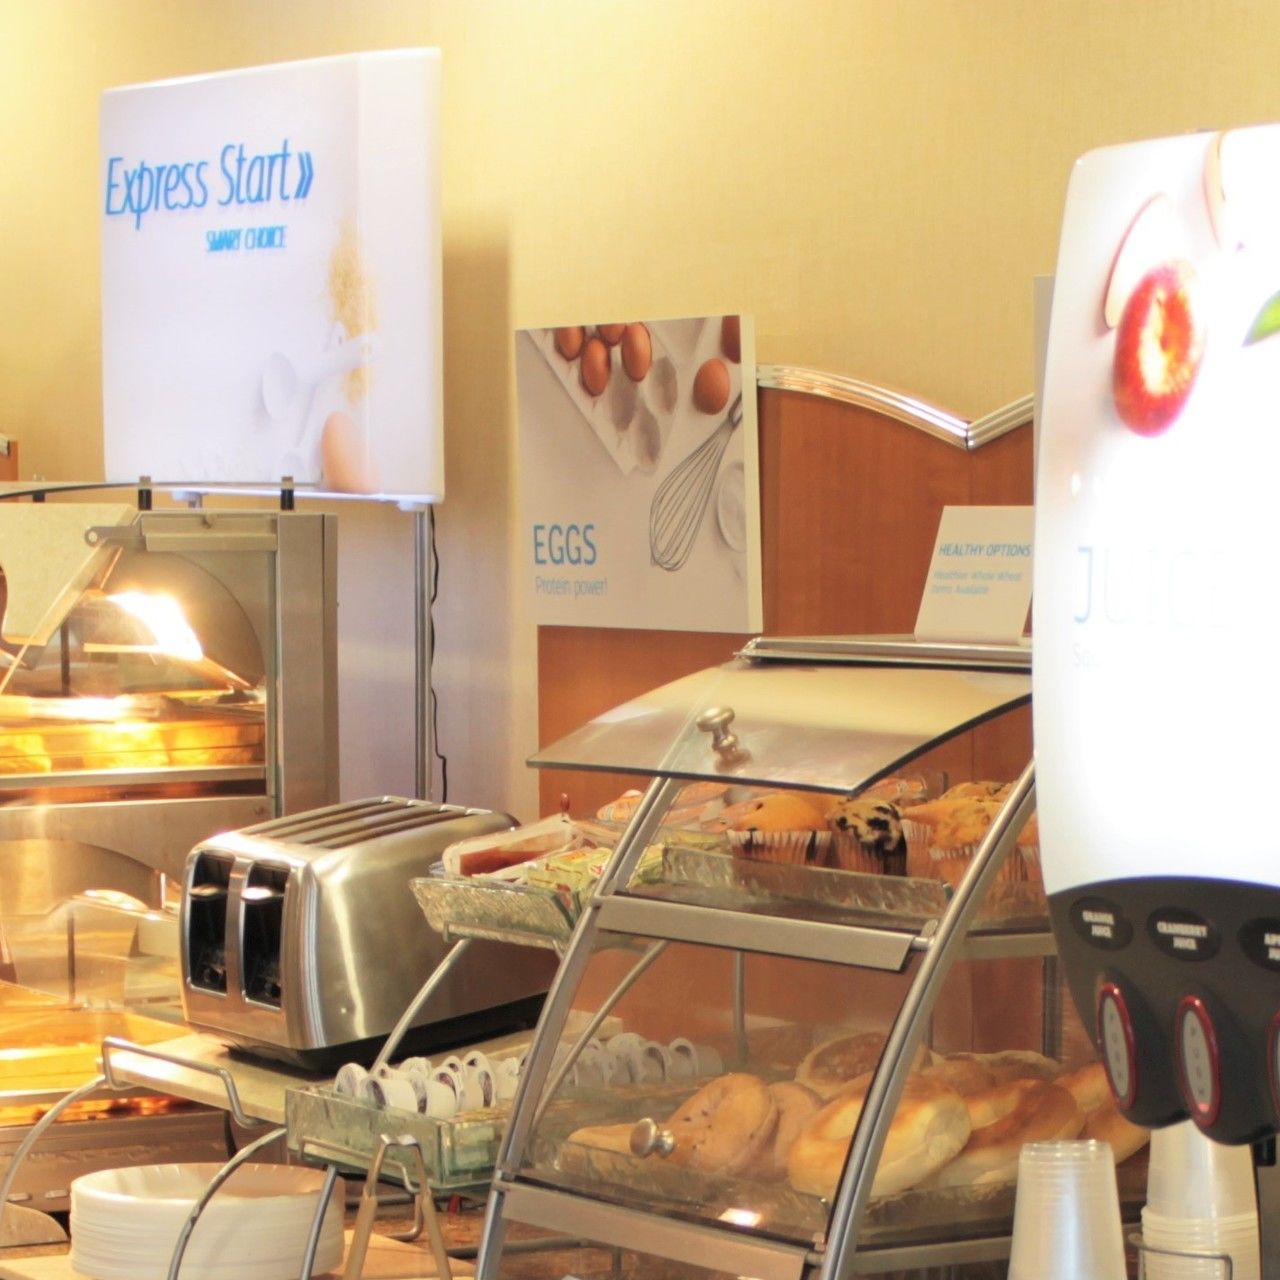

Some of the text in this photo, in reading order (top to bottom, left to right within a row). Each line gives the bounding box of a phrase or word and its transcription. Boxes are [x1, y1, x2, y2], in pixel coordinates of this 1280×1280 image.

[105, 156, 209, 230] Express
[205, 228, 242, 252] SMART
[533, 523, 598, 566] EGGS
[937, 543, 1033, 557] HEALTHY OPTIONS
[535, 576, 608, 600] Protein power!
[1091, 925, 1112, 938] JUICE
[1157, 921, 1208, 937] CRANBERRY
[1173, 937, 1197, 950] JUICE
[1189, 1025, 1205, 1095] PUSH
